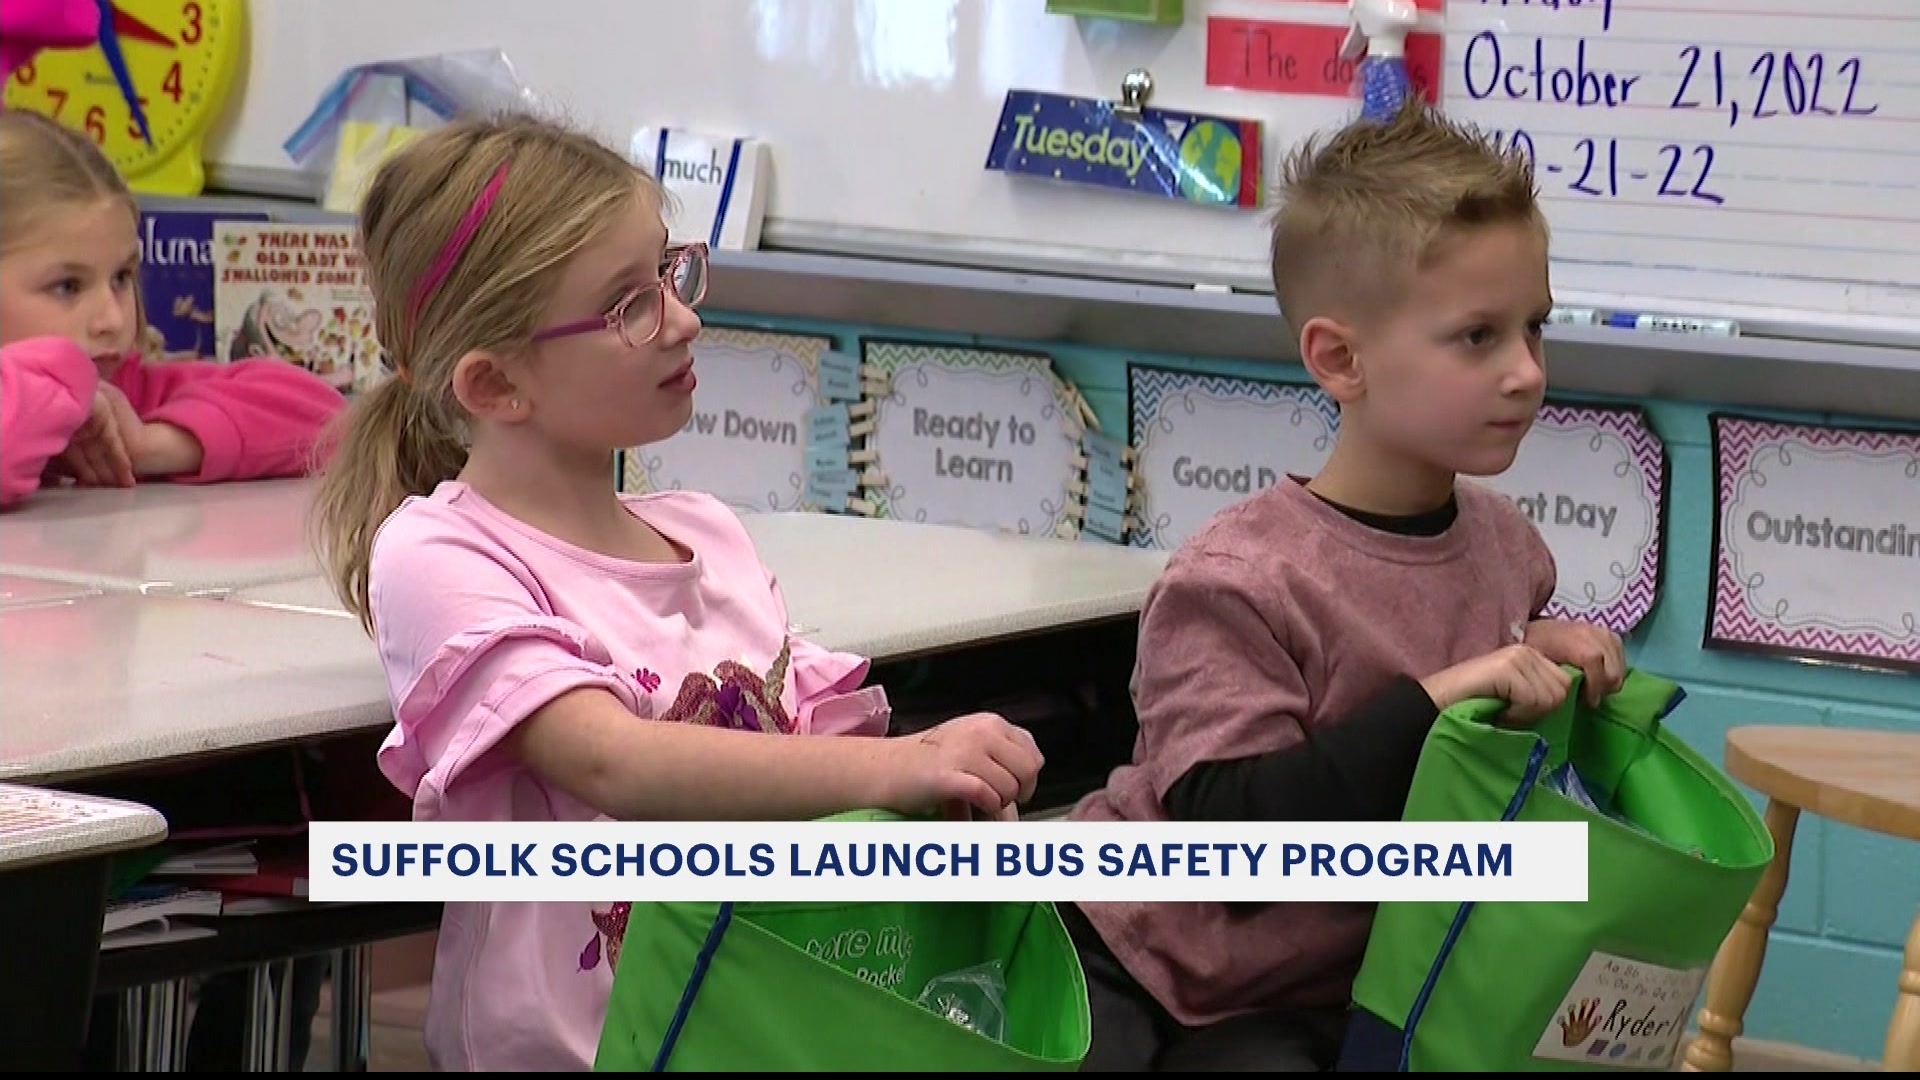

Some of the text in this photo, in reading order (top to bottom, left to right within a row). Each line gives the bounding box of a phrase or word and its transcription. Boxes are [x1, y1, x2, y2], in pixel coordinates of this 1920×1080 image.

[181, 2, 202, 45] 3
[1231, 27, 1298, 81] The
[1464, 30, 1641, 107] October
[47, 87, 68, 119] 7
[162, 61, 183, 104] 4
[86, 105, 106, 145] 6
[663, 147, 723, 185] much
[1012, 114, 1150, 178] Tuesday
[256, 251, 290, 266] OLD
[296, 252, 339, 268] LADY
[313, 232, 350, 248] WAS
[316, 272, 356, 286] SOME
[723, 408, 798, 446] Down
[912, 407, 1036, 449] Ready to
[934, 447, 1014, 483] Learn
[1172, 455, 1250, 494] Good
[1554, 493, 1618, 538] Day
[1746, 509, 1920, 558] Outstandin
[1601, 998, 1670, 1041] Ryder
